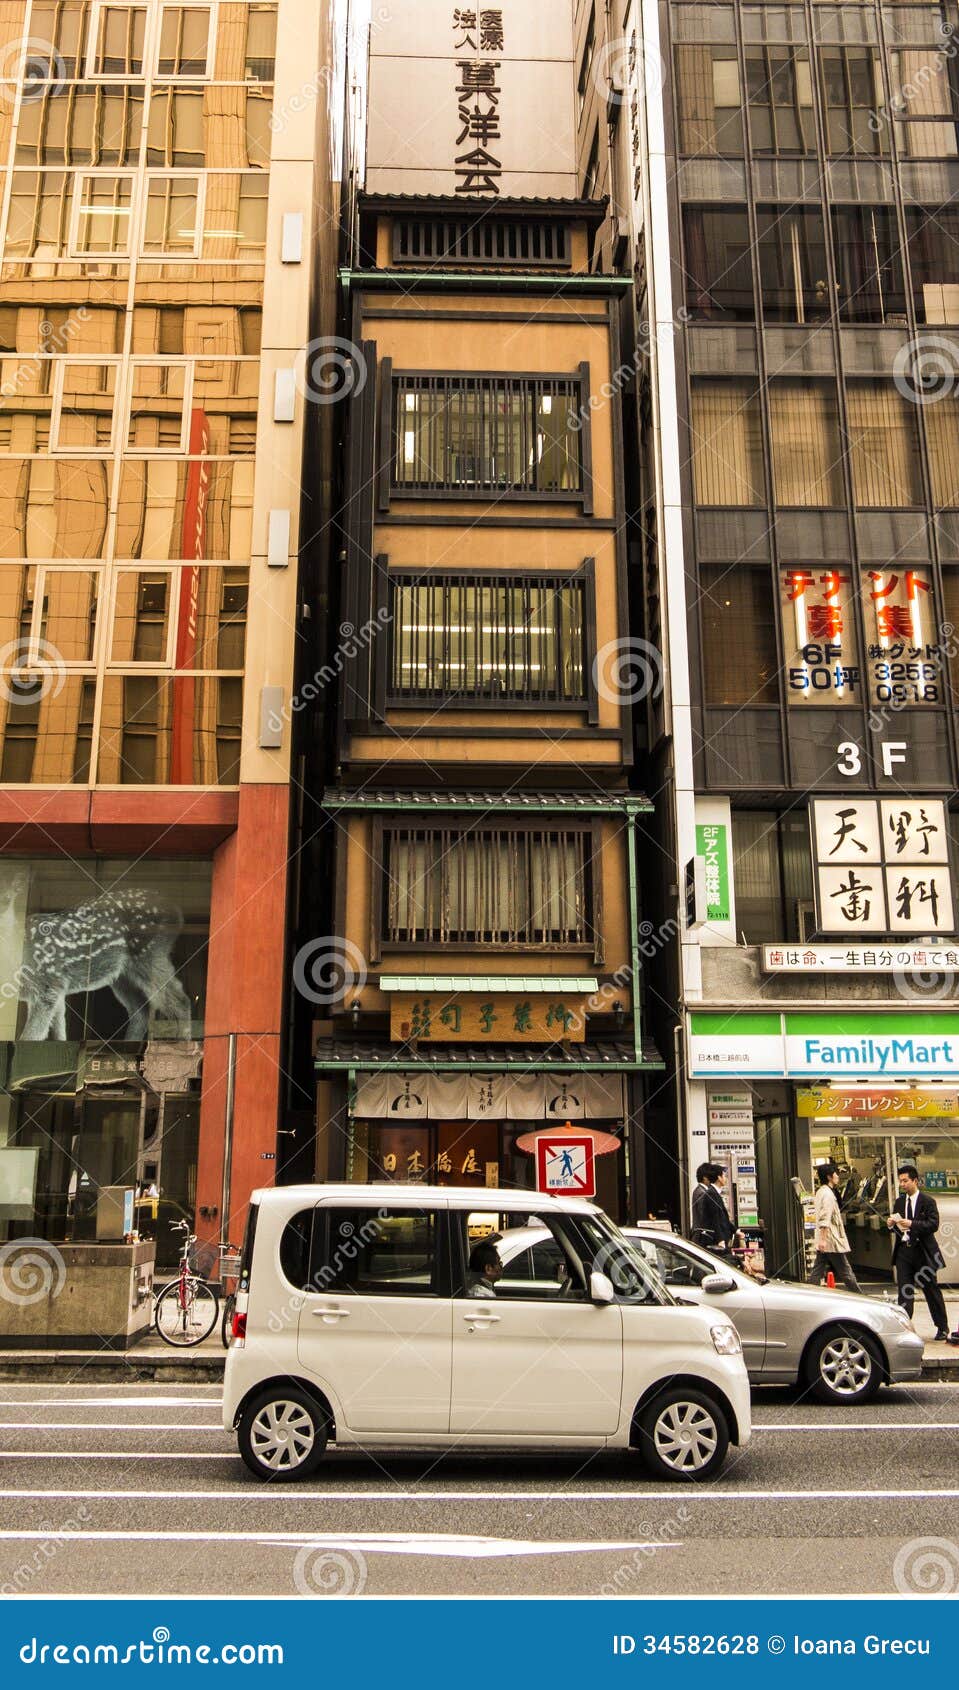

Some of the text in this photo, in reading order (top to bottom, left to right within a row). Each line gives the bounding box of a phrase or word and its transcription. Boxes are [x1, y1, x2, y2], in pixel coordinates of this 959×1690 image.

[452, 9, 477, 50] 法人
[480, 9, 504, 51] 医療
[784, 570, 930, 600] テナント
[802, 643, 842, 665] 6F
[789, 666, 860, 691] 50坪
[875, 663, 937, 681] 3256
[876, 685, 938, 702] 0918
[703, 827, 719, 838] 2F
[829, 808, 938, 856] 天野
[830, 870, 939, 926] 歯科
[805, 1039, 953, 1071] FamilyMart
